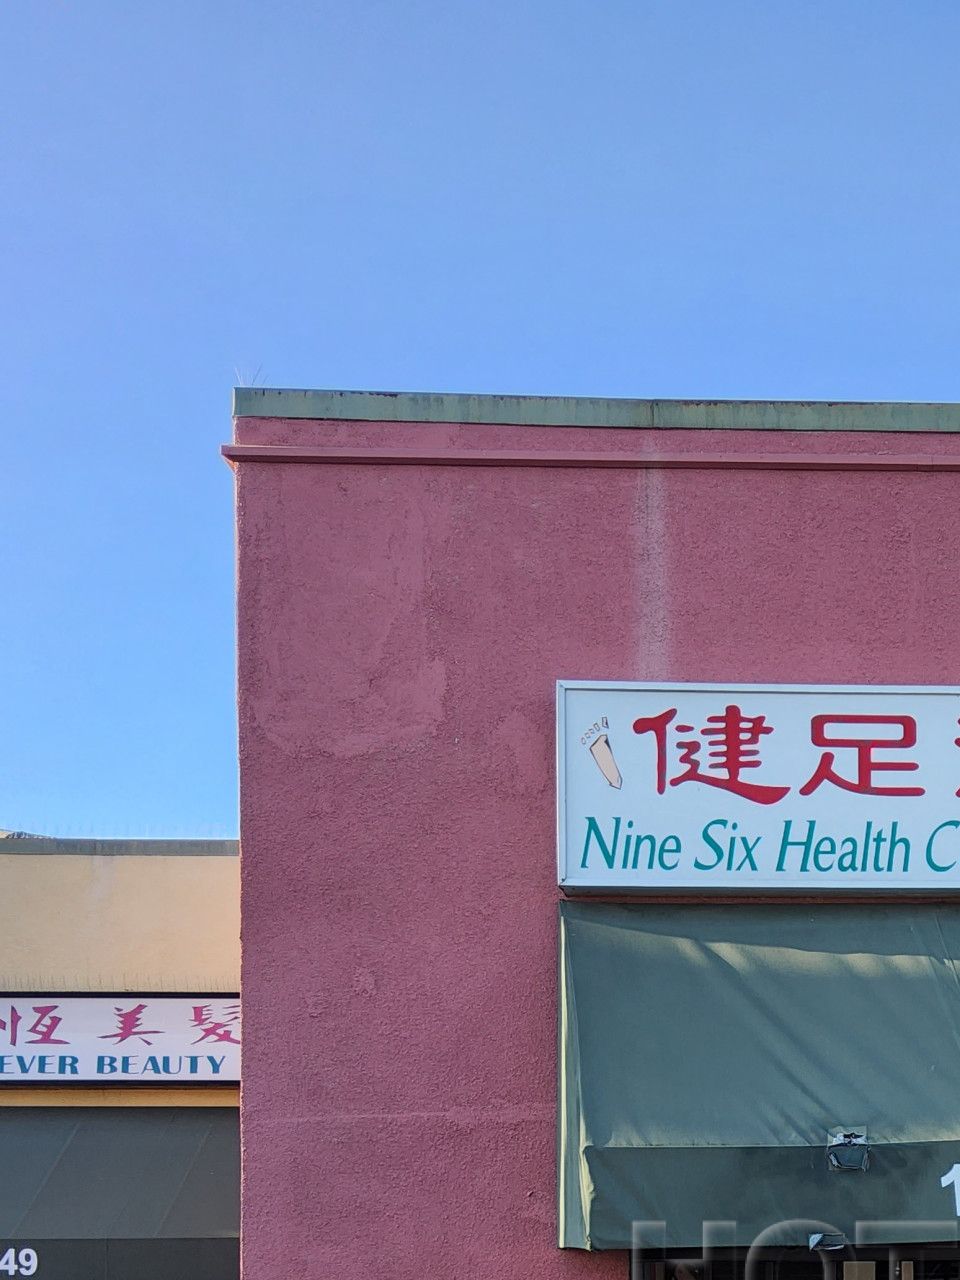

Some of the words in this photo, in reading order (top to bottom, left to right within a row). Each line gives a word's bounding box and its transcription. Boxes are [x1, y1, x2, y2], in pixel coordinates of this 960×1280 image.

[579, 815, 683, 873] Nine
[691, 817, 763, 873] Six
[775, 818, 912, 874] Health
[0, 1055, 79, 1075] EVER
[96, 1055, 226, 1075] BEAUTY
